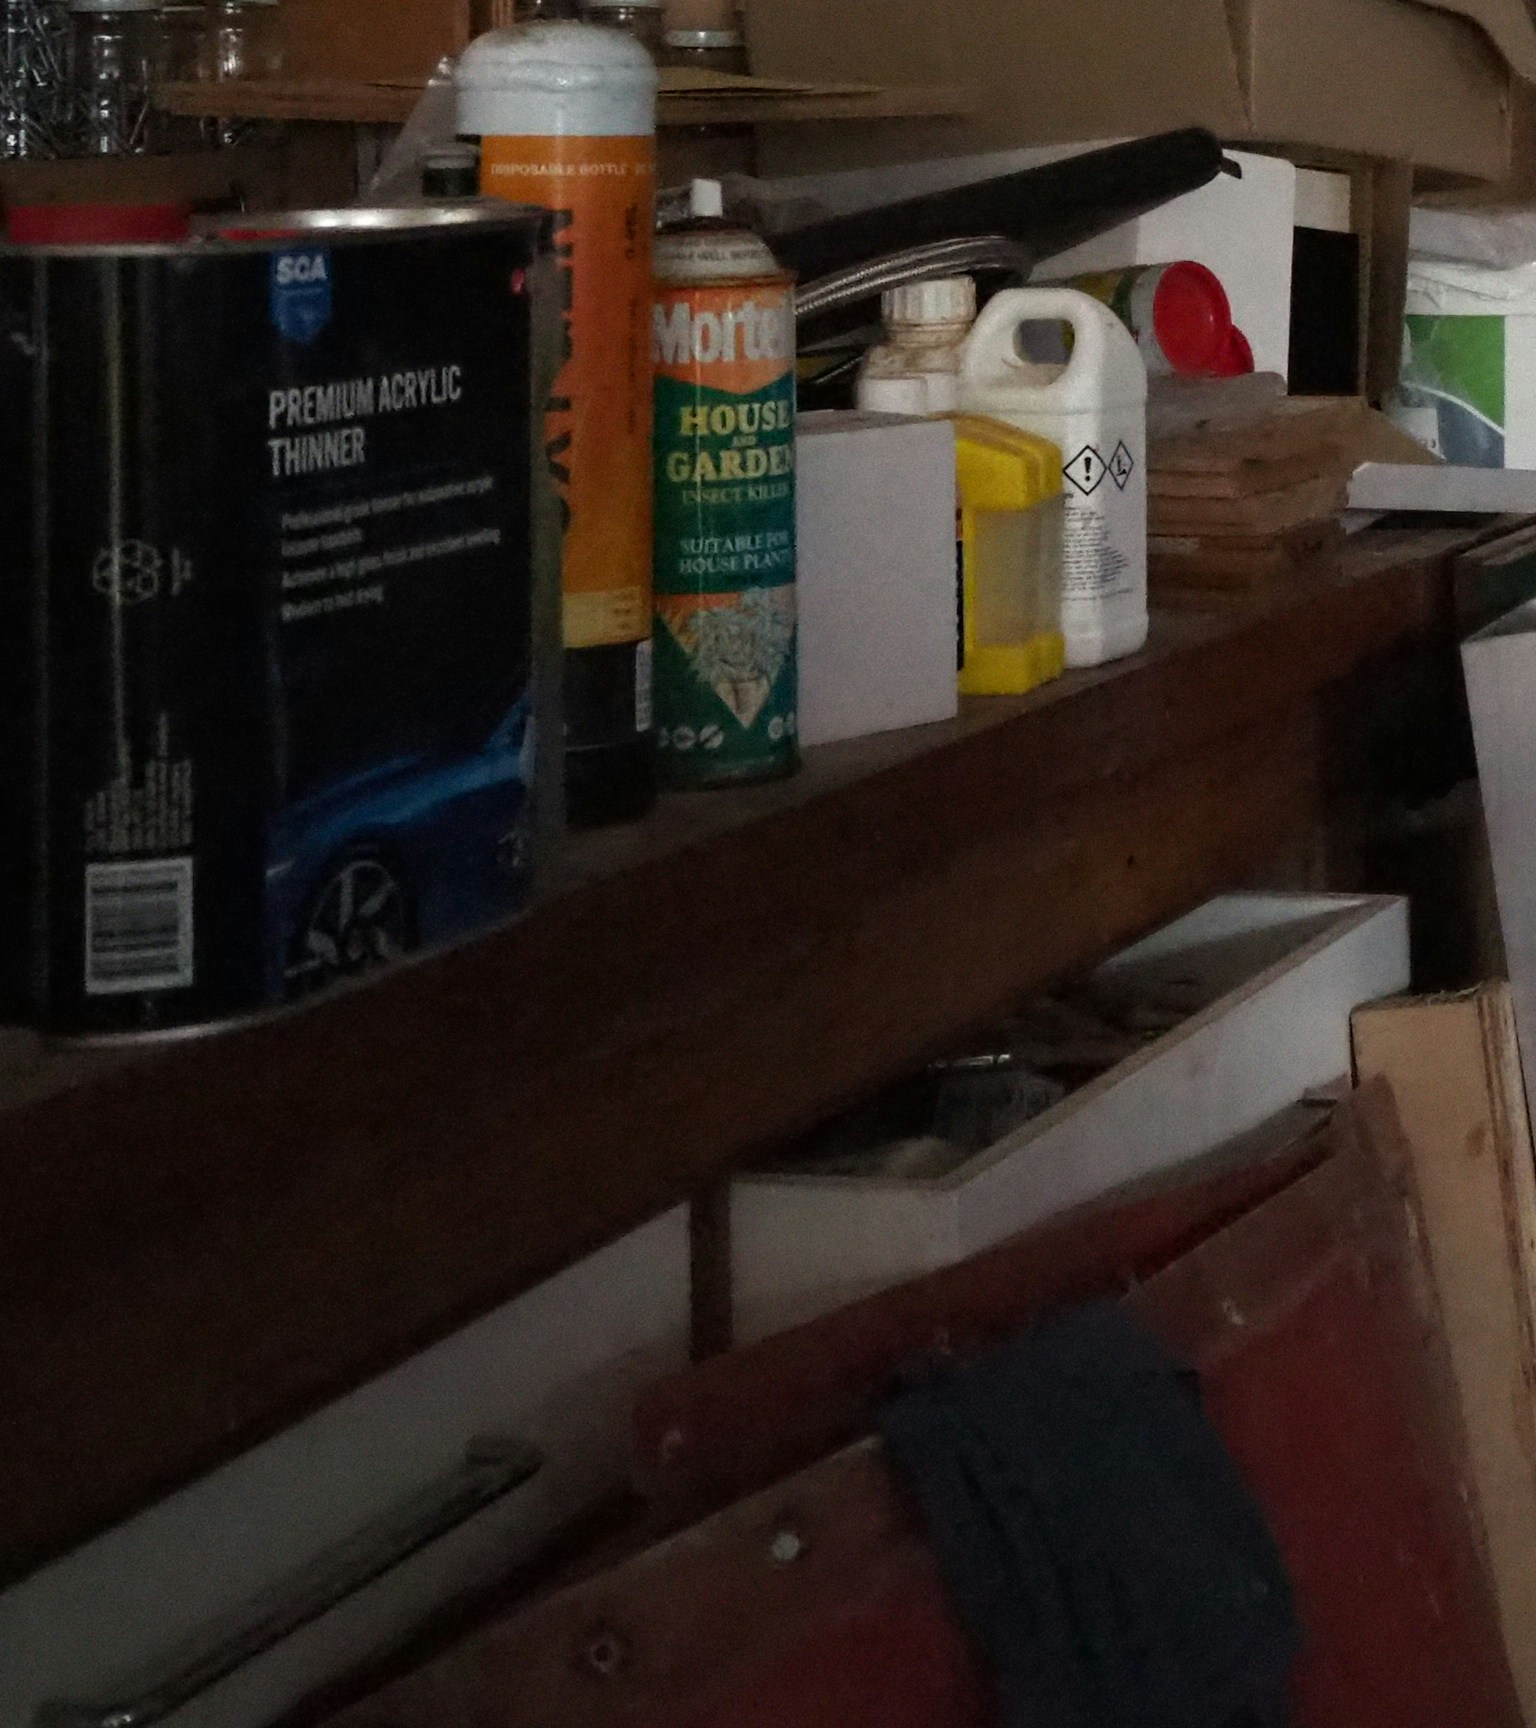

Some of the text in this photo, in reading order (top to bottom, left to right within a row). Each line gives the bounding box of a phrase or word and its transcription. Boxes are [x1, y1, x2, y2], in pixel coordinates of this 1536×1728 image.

[276, 253, 329, 285] SCA
[268, 364, 463, 430] PREMIUM ACRYLIC
[679, 399, 792, 437] HOUSE
[267, 425, 366, 477] THINNER
[679, 554, 740, 573] HOUSE
